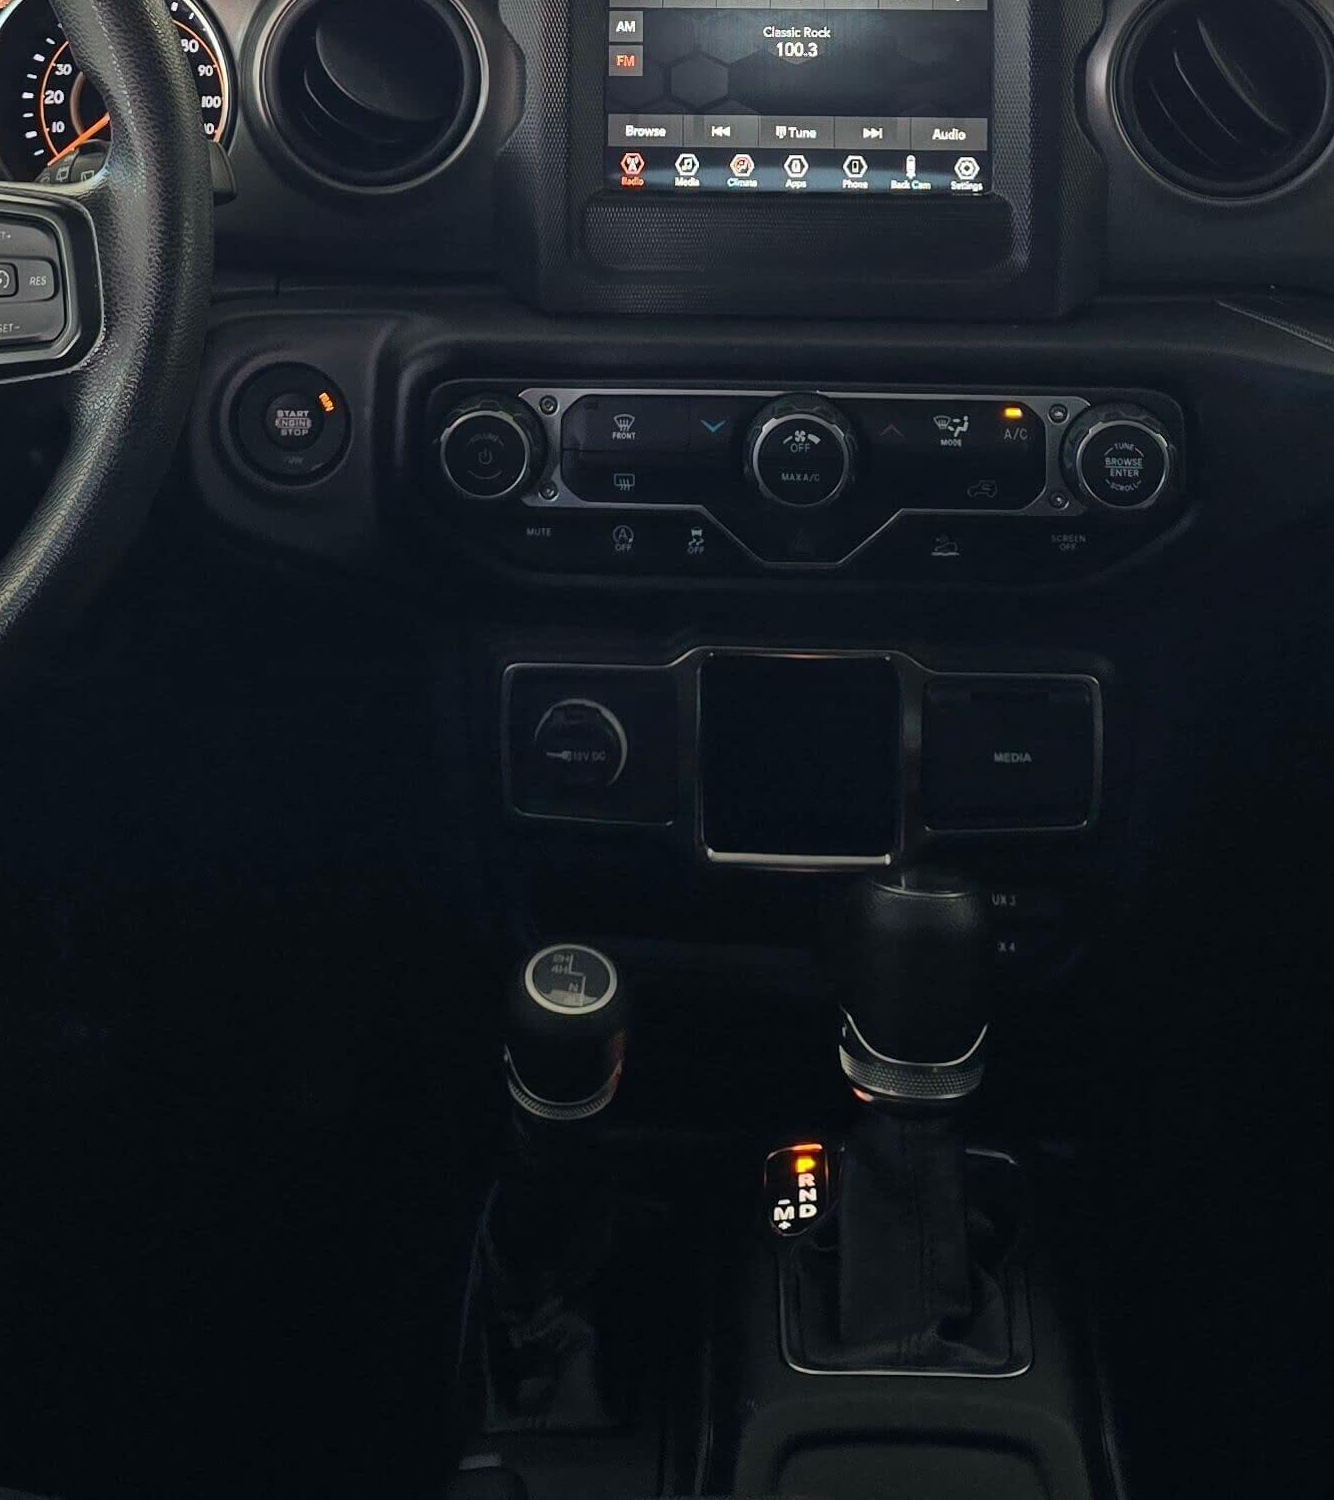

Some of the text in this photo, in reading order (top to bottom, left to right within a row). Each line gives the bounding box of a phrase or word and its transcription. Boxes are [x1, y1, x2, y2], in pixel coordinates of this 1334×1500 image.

[616, 21, 636, 33] AM
[763, 27, 831, 38] Classic Rock
[616, 55, 636, 67] FM
[54, 63, 73, 76] 30
[197, 64, 214, 77] 90
[44, 89, 65, 105] 20
[201, 95, 222, 109] 100
[51, 120, 66, 133] 10
[625, 125, 667, 137] Browse
[788, 127, 817, 139] Tune
[932, 128, 967, 141] Audio
[674, 177, 700, 187] Media
[785, 179, 807, 190] Apps
[842, 179, 869, 189] Phone
[950, 181, 984, 193] Settings
[29, 276, 47, 286] RES
[277, 409, 310, 418] START
[275, 419, 312, 429] ENGINE
[280, 428, 309, 436] STOP
[612, 432, 636, 440] FRONT
[1003, 428, 1028, 441] A/C
[790, 443, 811, 453] OFF
[1114, 442, 1135, 451] TUNE
[1105, 457, 1142, 467] BROWSE
[1110, 469, 1139, 477] ENTER
[526, 527, 552, 537] MUTE
[994, 751, 1032, 763] MEDIA
[796, 1157, 816, 1173] P
[798, 1173, 816, 1188] R
[798, 1188, 817, 1202] N
[774, 1206, 795, 1221] M
[799, 1203, 817, 1218] D
